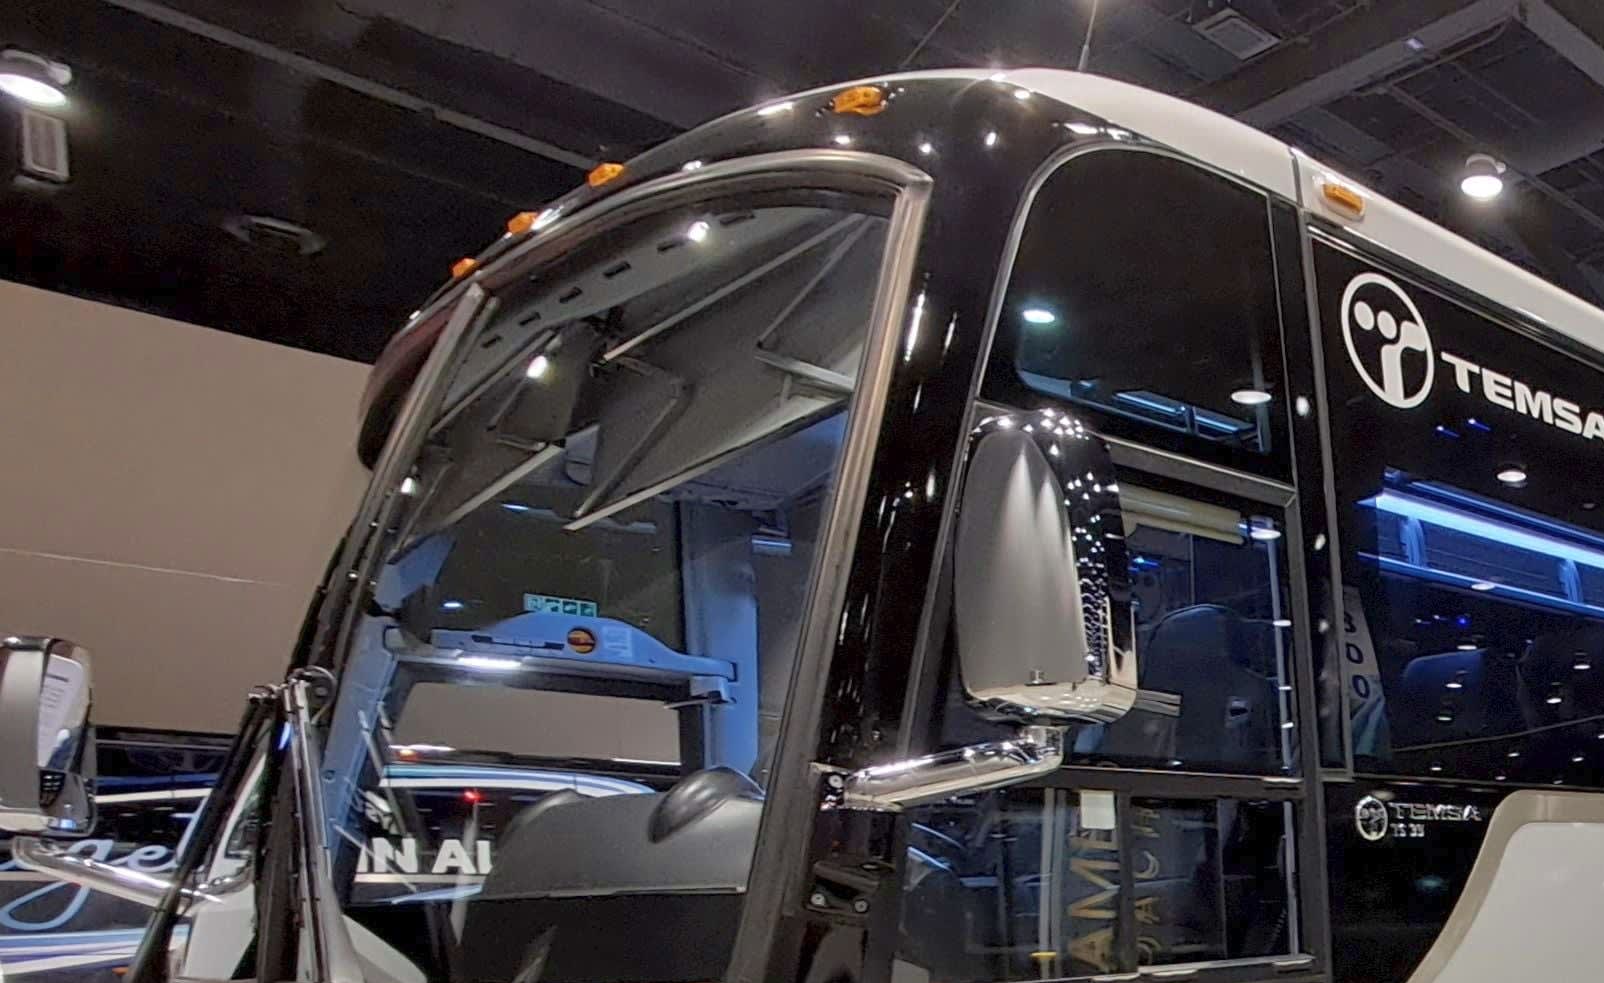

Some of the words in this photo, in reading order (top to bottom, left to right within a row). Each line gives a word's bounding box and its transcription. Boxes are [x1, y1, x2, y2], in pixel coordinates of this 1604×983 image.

[1387, 802, 1483, 822] TEMSA
[1390, 823, 1407, 838] TS
[356, 837, 419, 874] IN
